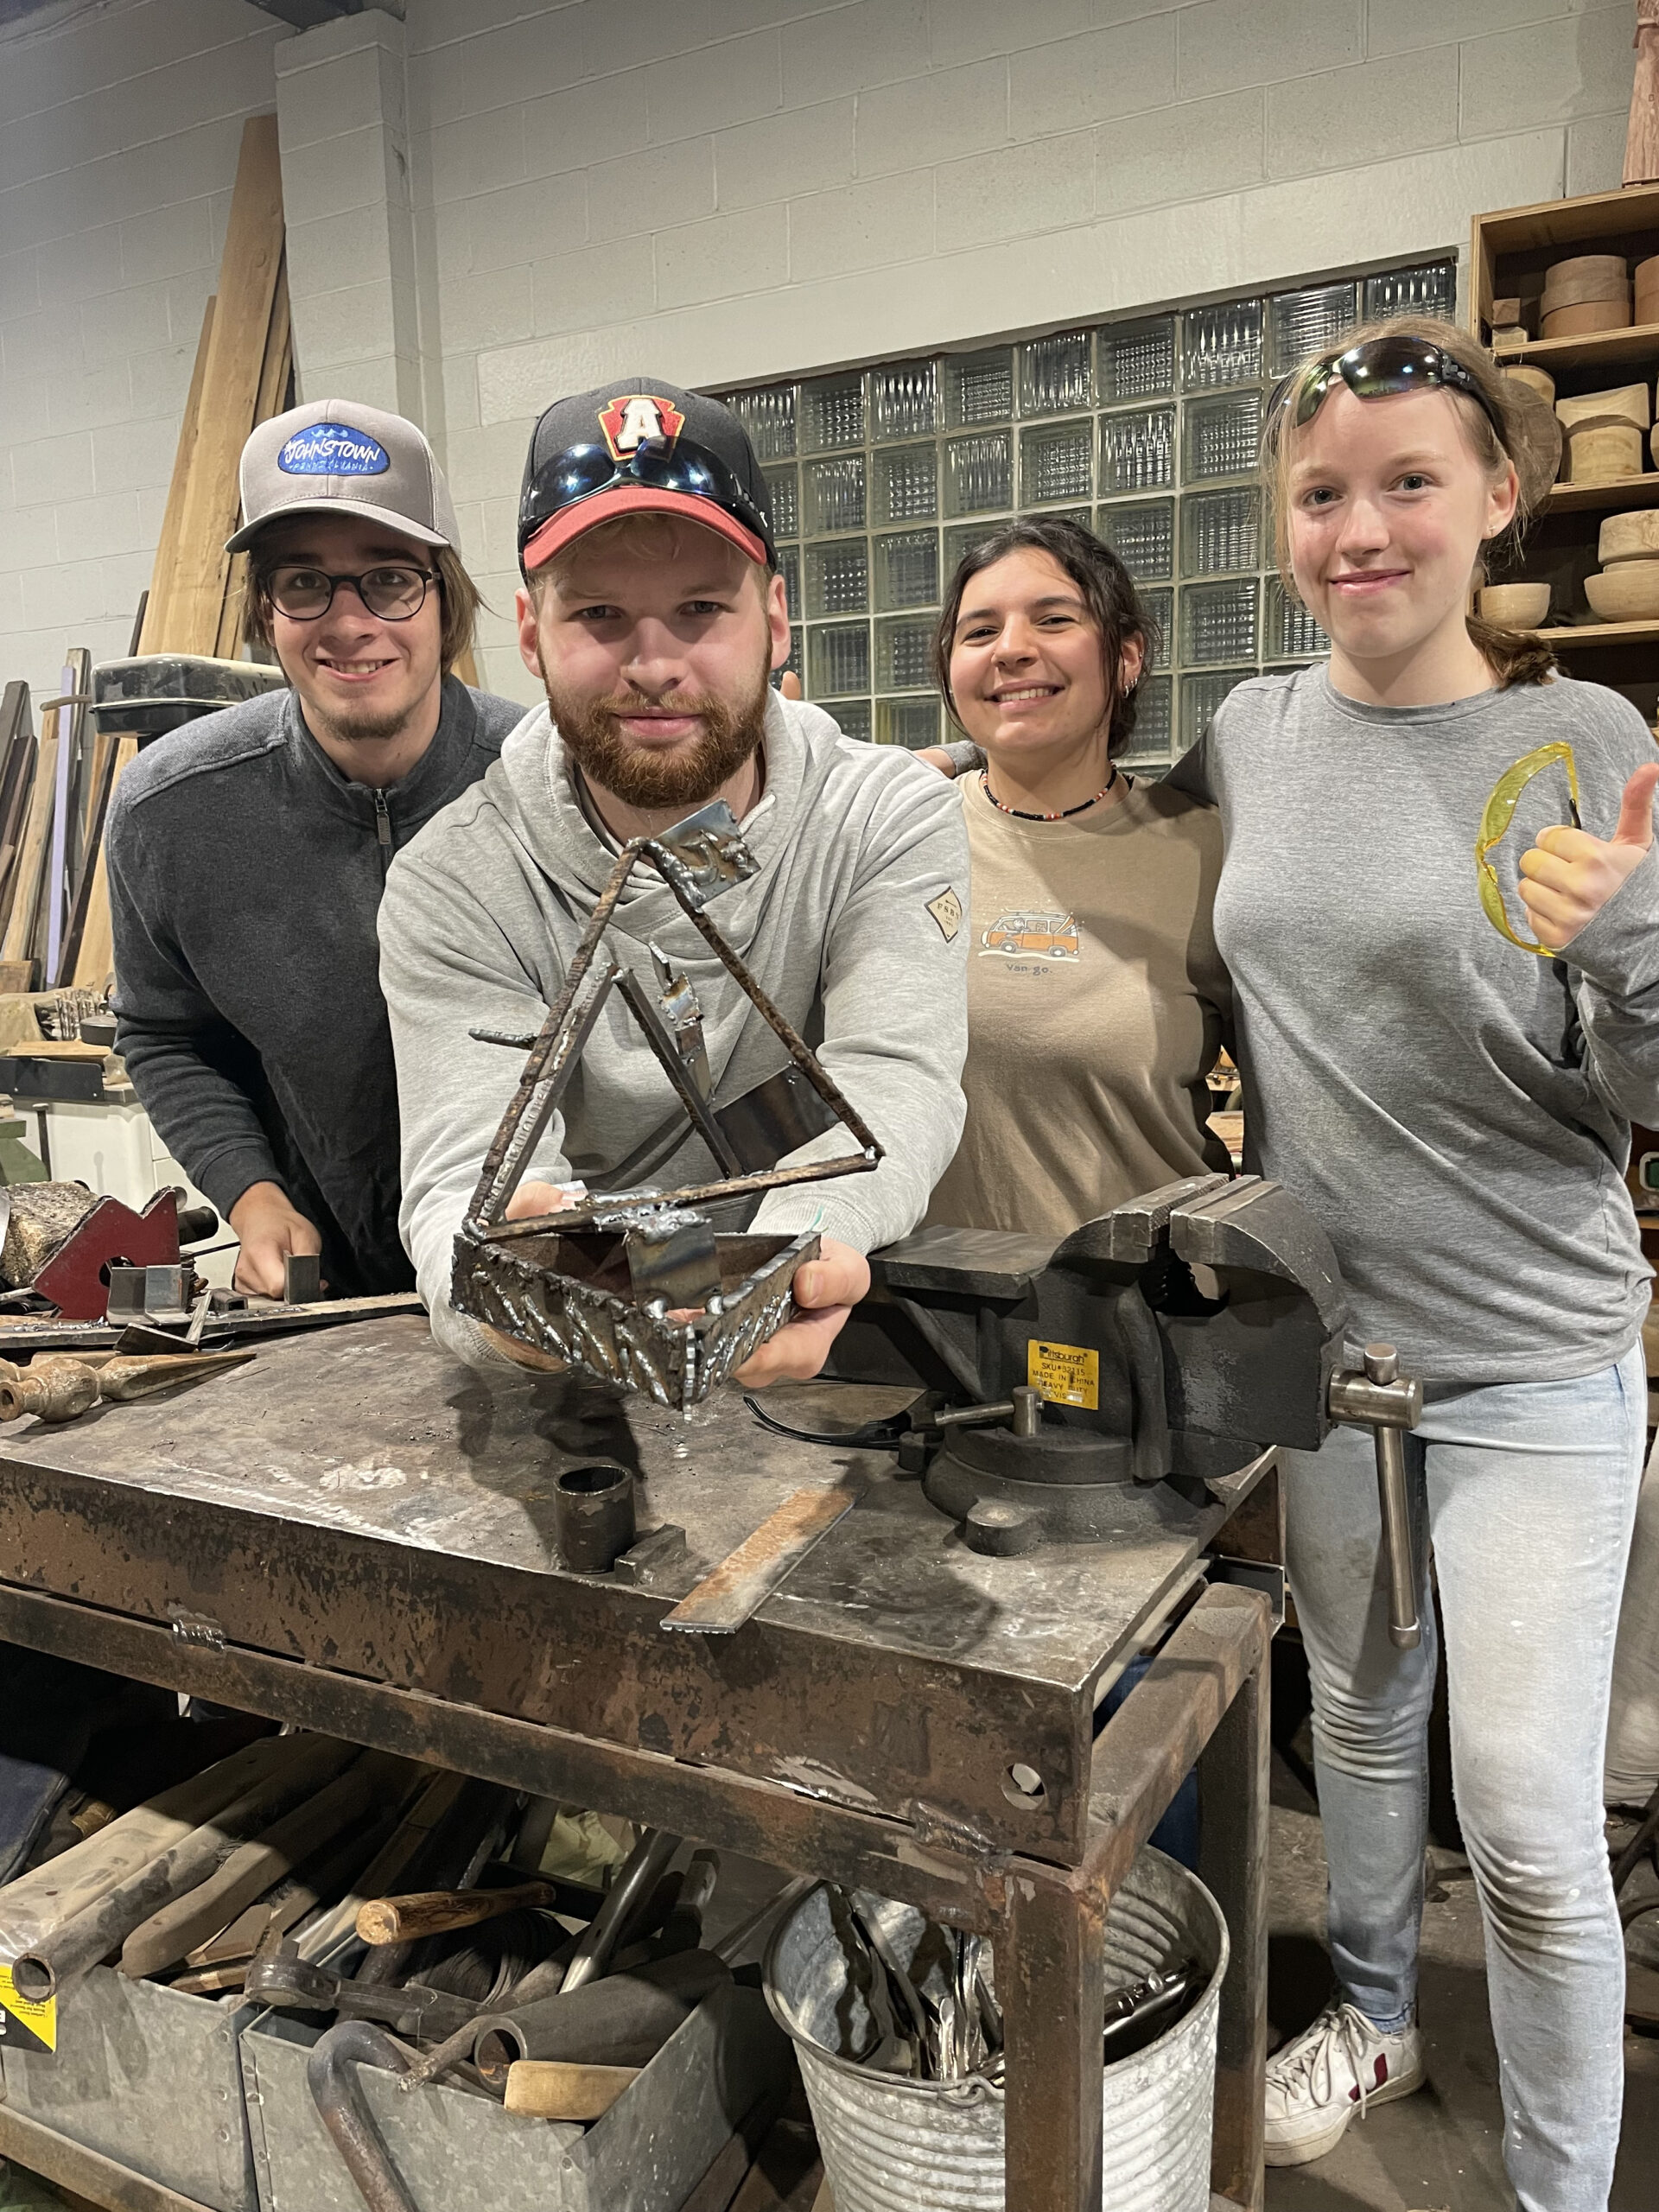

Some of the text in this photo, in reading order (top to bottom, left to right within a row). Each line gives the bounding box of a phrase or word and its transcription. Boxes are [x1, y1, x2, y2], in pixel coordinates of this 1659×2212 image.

[616, 398, 666, 450] A
[284, 438, 380, 463] JOHNSTOWN
[1033, 1370, 1054, 1379] MADE
[1054, 1391, 1072, 1400] VIS
